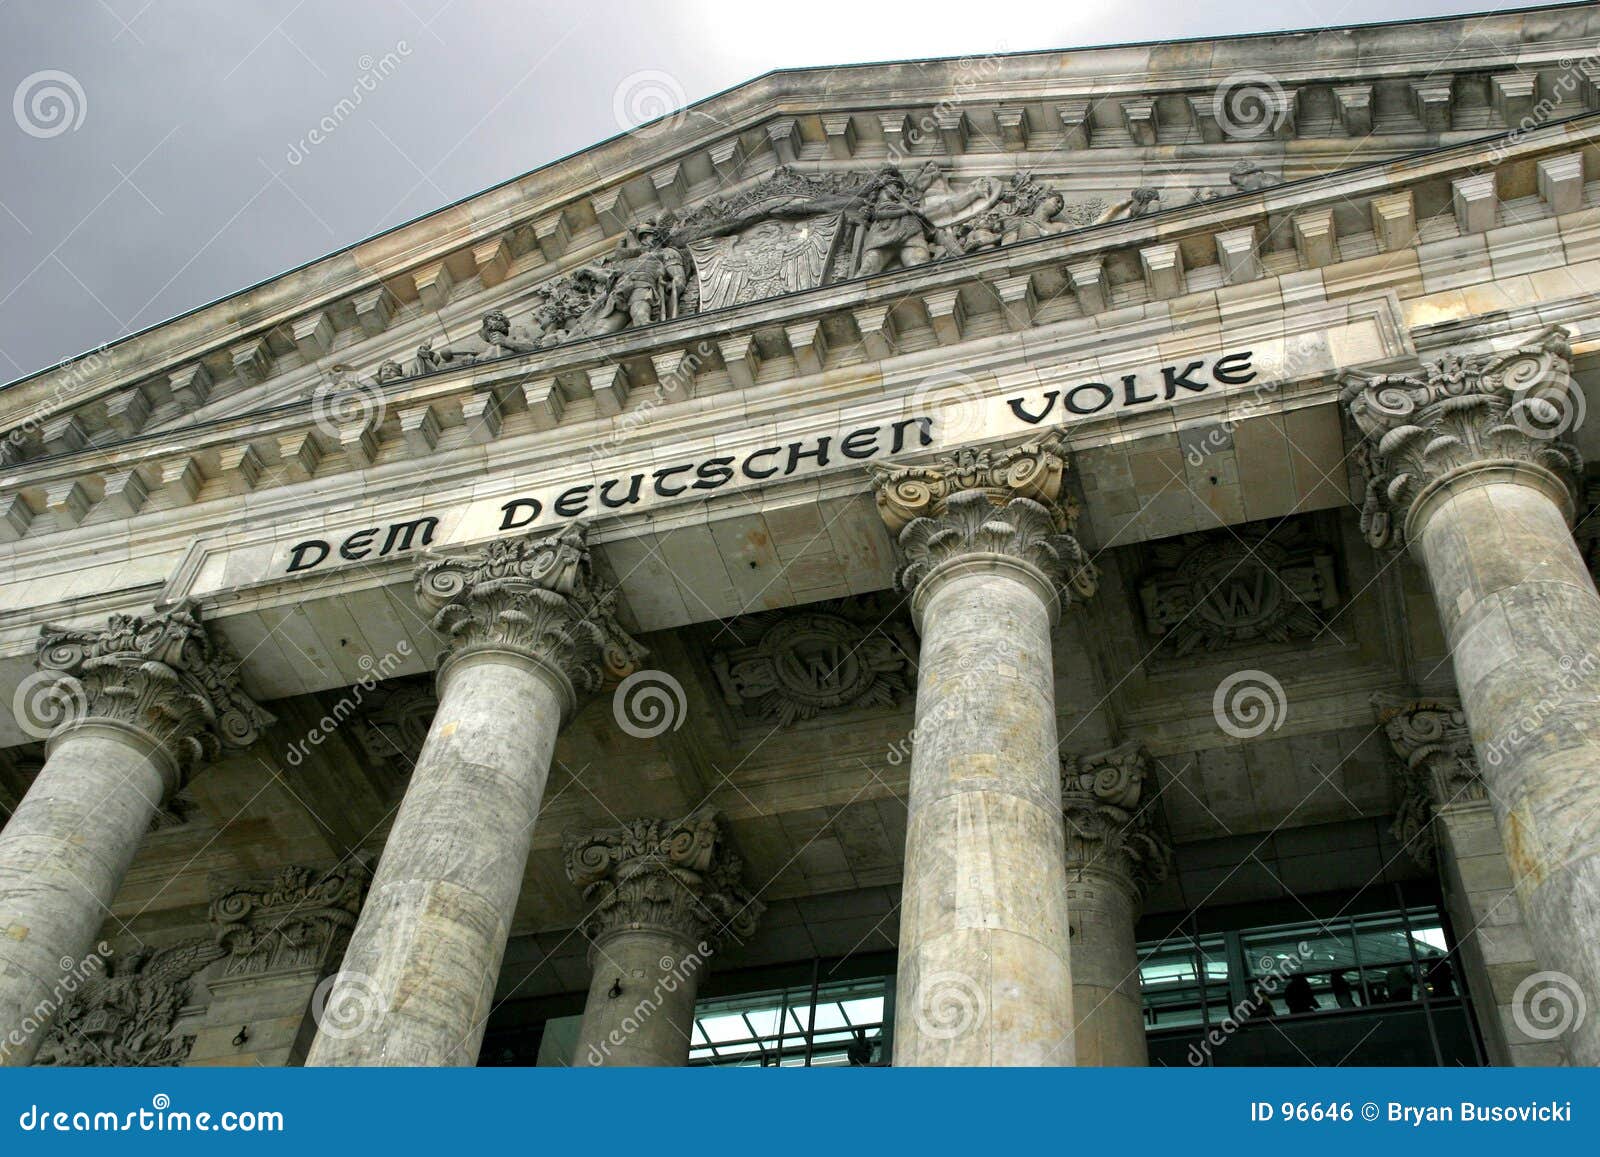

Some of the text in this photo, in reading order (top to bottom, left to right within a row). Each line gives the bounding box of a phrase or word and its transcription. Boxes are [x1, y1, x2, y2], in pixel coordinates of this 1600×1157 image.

[286, 351, 1257, 572] DEM DEUTSCHEN VOLKE
